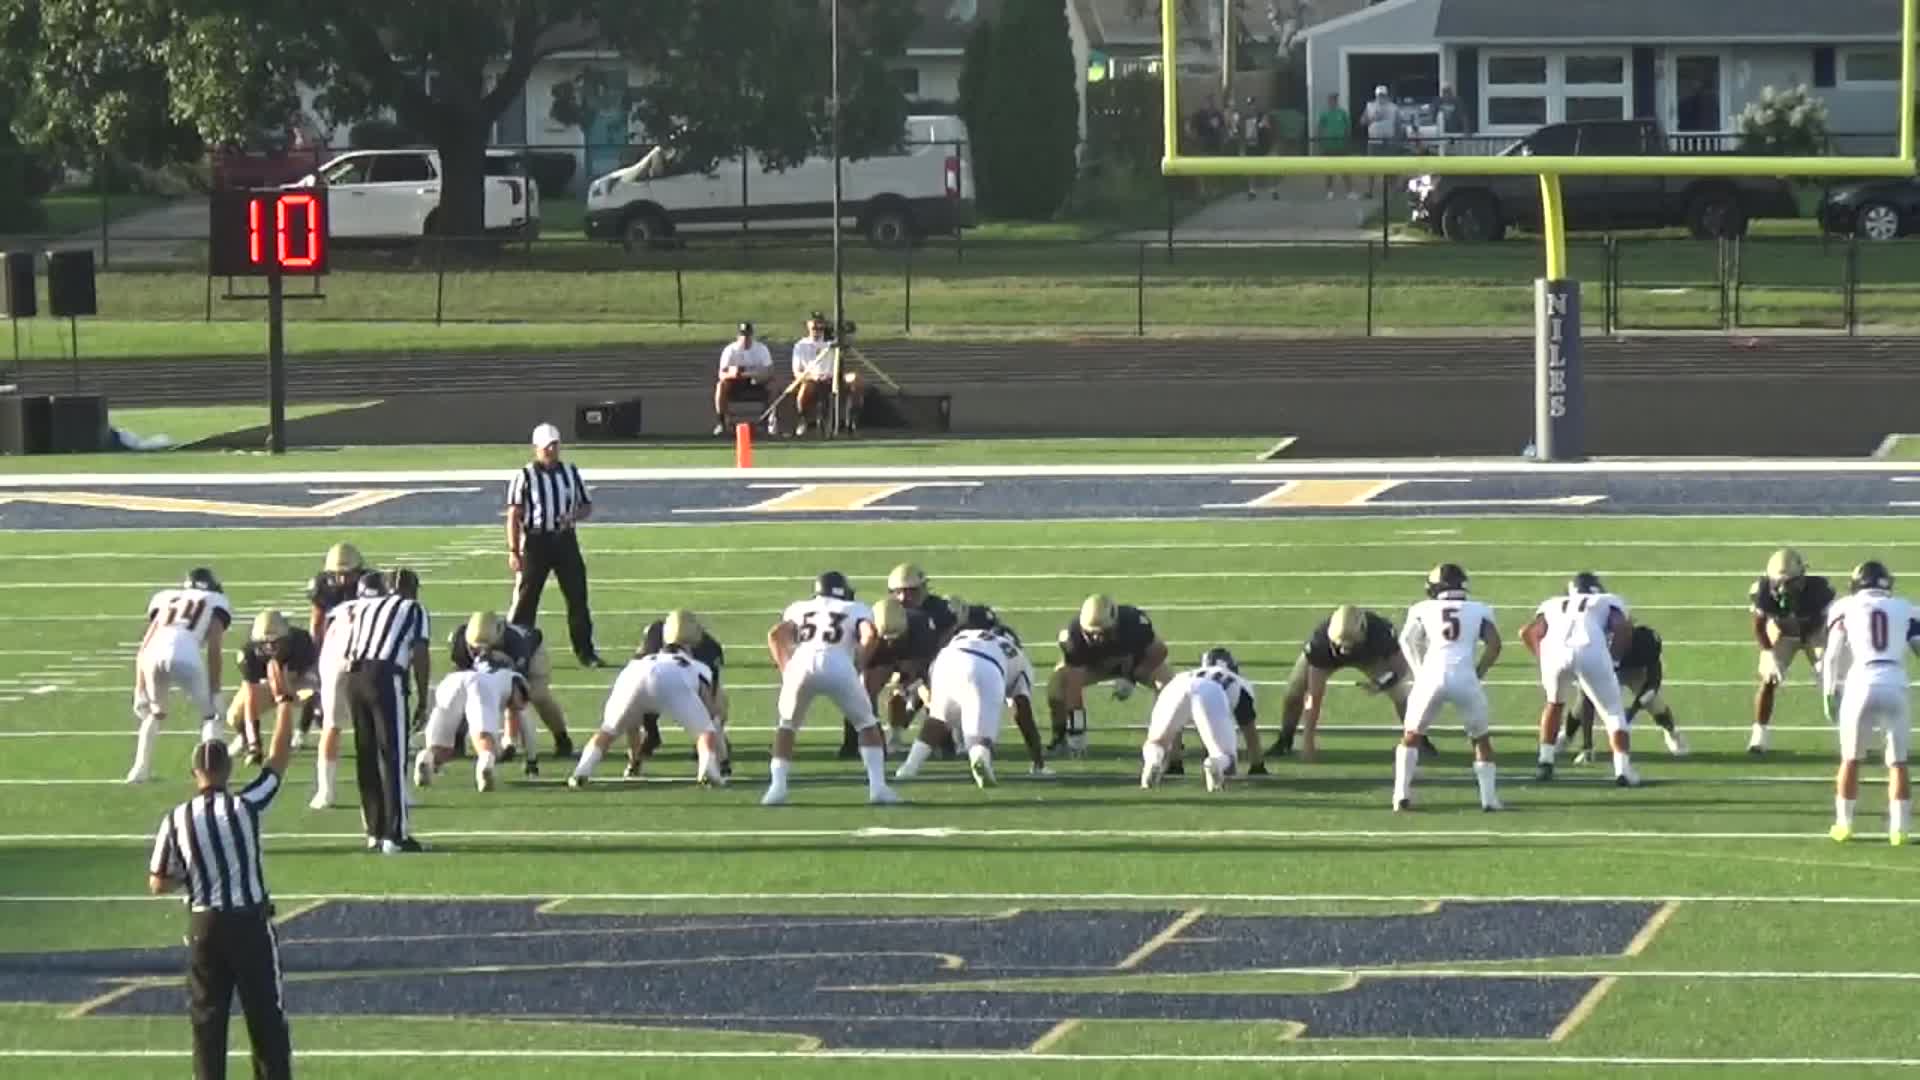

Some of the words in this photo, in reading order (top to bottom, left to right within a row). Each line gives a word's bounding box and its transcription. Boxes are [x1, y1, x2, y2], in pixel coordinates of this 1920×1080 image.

[249, 195, 317, 267] 10
[1547, 293, 1568, 416] NILES
[799, 611, 848, 644] 53
[1442, 608, 1460, 641] 5
[1869, 609, 1888, 652] 0
